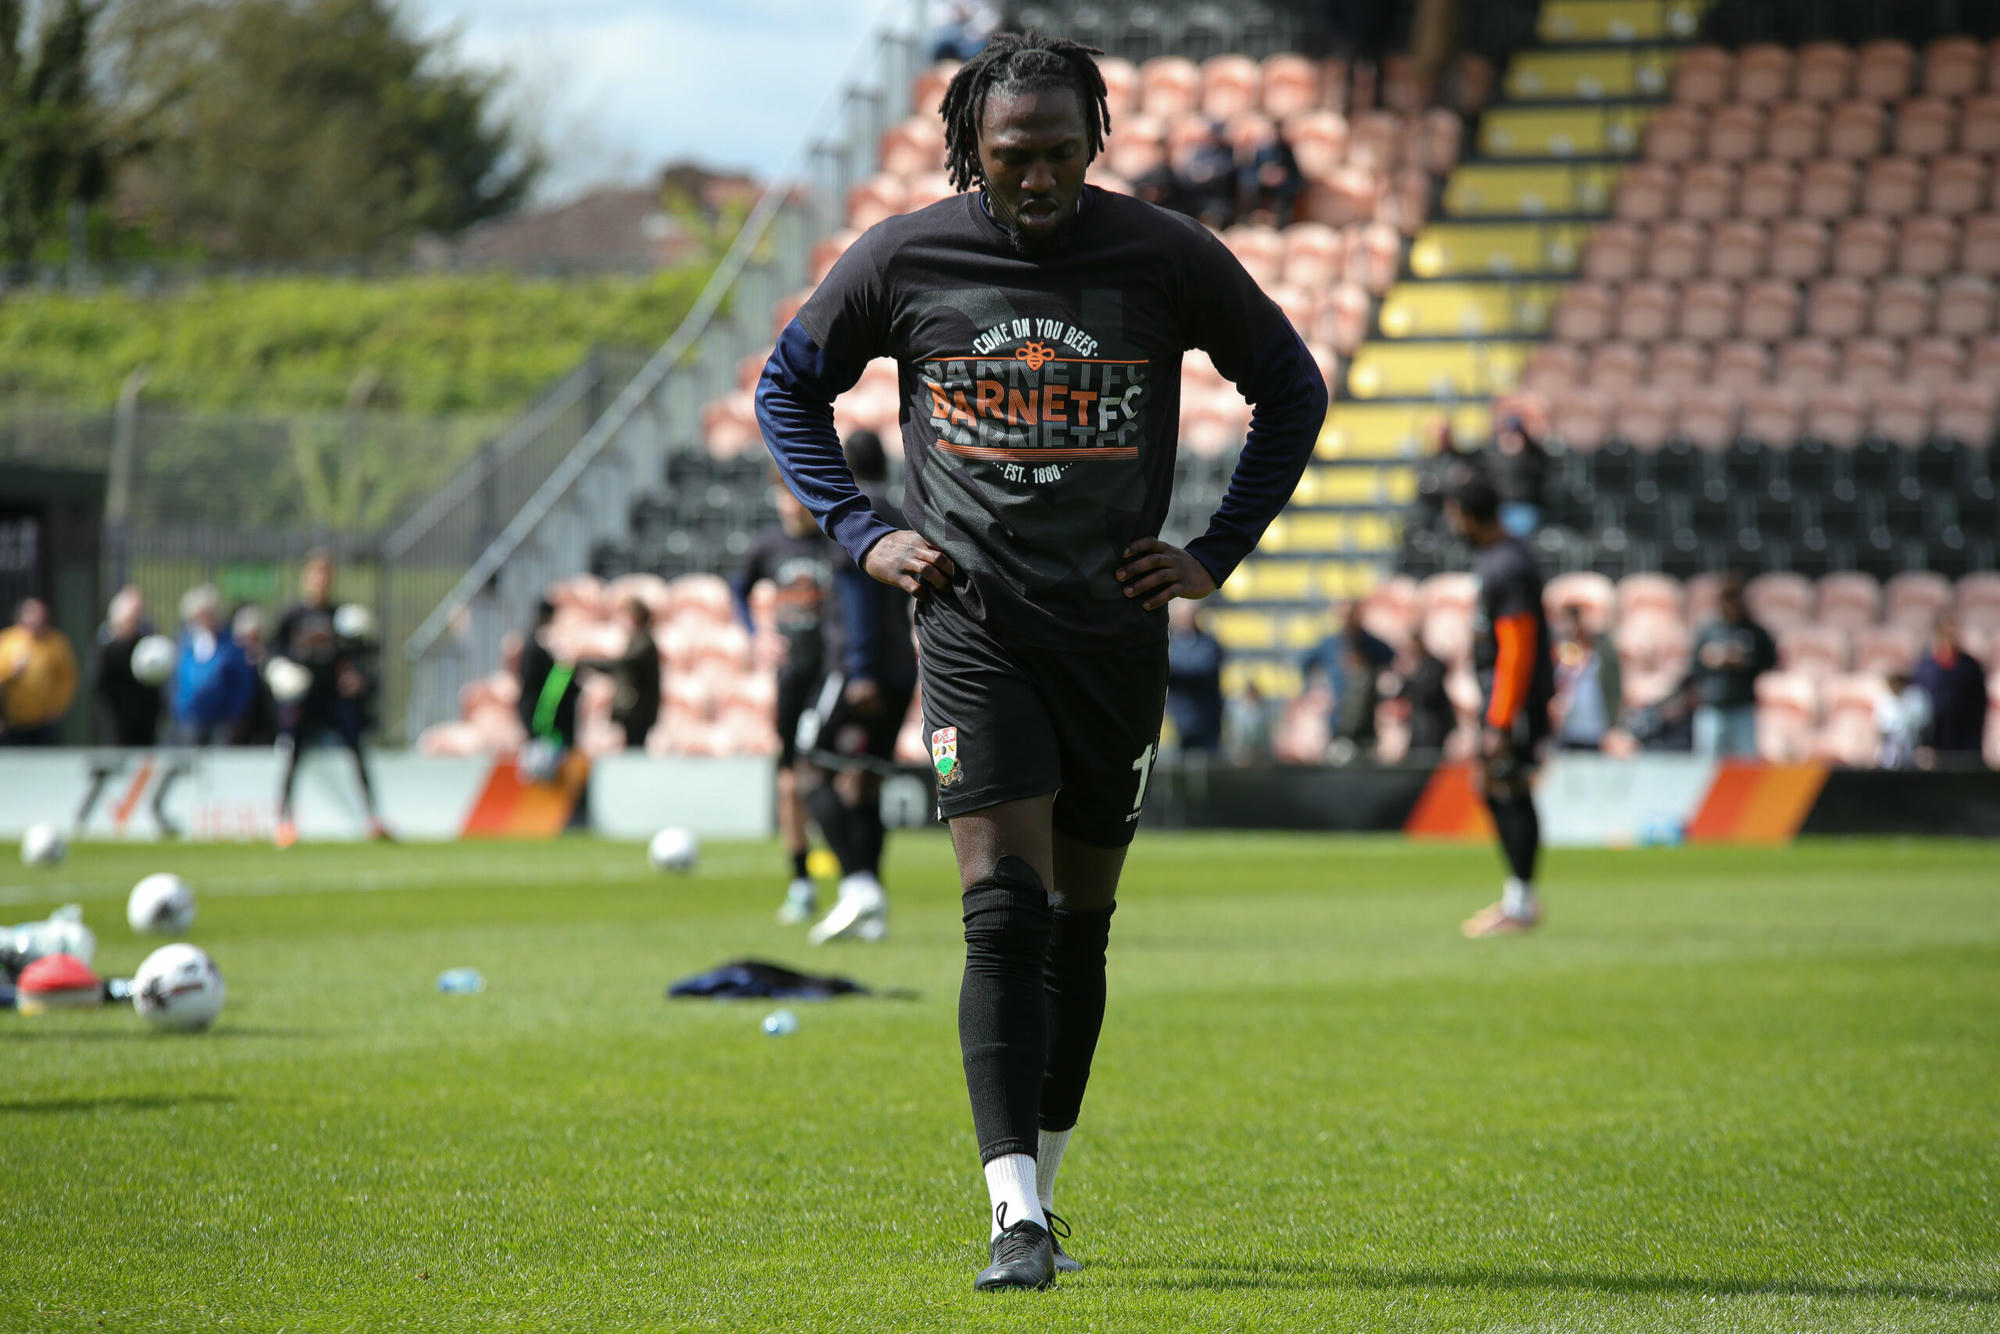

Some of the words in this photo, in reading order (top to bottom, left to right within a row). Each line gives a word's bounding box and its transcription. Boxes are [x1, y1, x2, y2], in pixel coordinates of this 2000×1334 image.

[973, 323, 1012, 355] COME
[1012, 318, 1031, 339] ON
[1036, 318, 1064, 340] YOU
[1063, 325, 1098, 357] BEES
[927, 380, 1097, 426] BARNET
[1004, 463, 1027, 483] EST.
[1032, 464, 1061, 484] 1888
